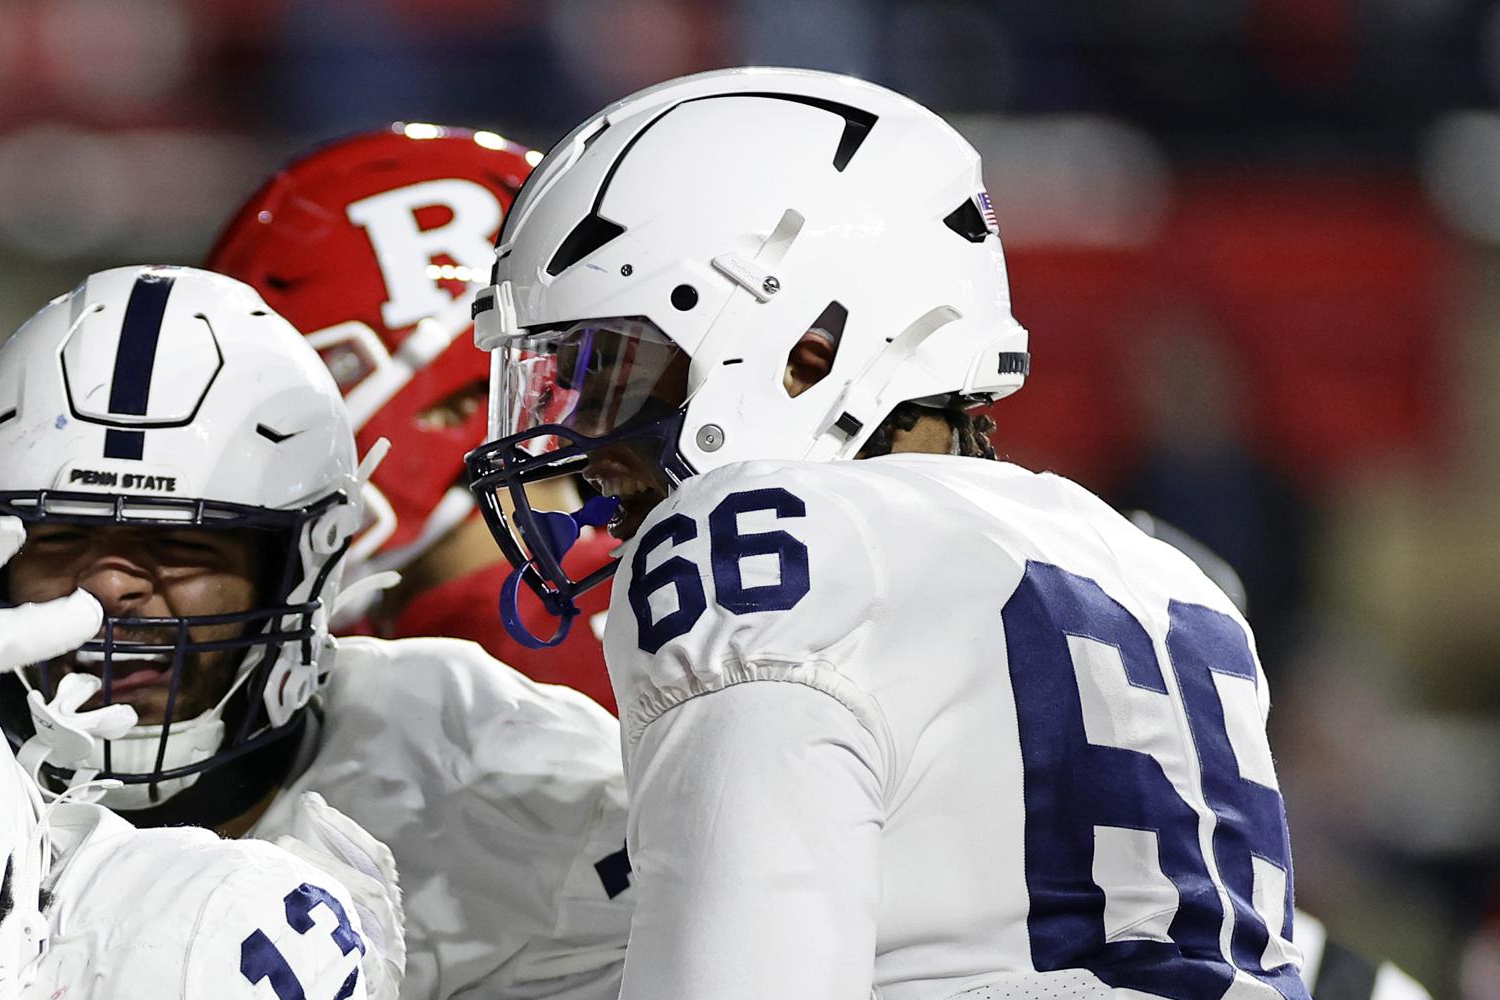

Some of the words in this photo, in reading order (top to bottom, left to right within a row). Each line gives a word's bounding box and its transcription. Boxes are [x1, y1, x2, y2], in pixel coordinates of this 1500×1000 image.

[347, 178, 503, 324] R
[69, 468, 118, 487] PENN
[121, 473, 177, 492] STATE
[628, 487, 811, 655] 66
